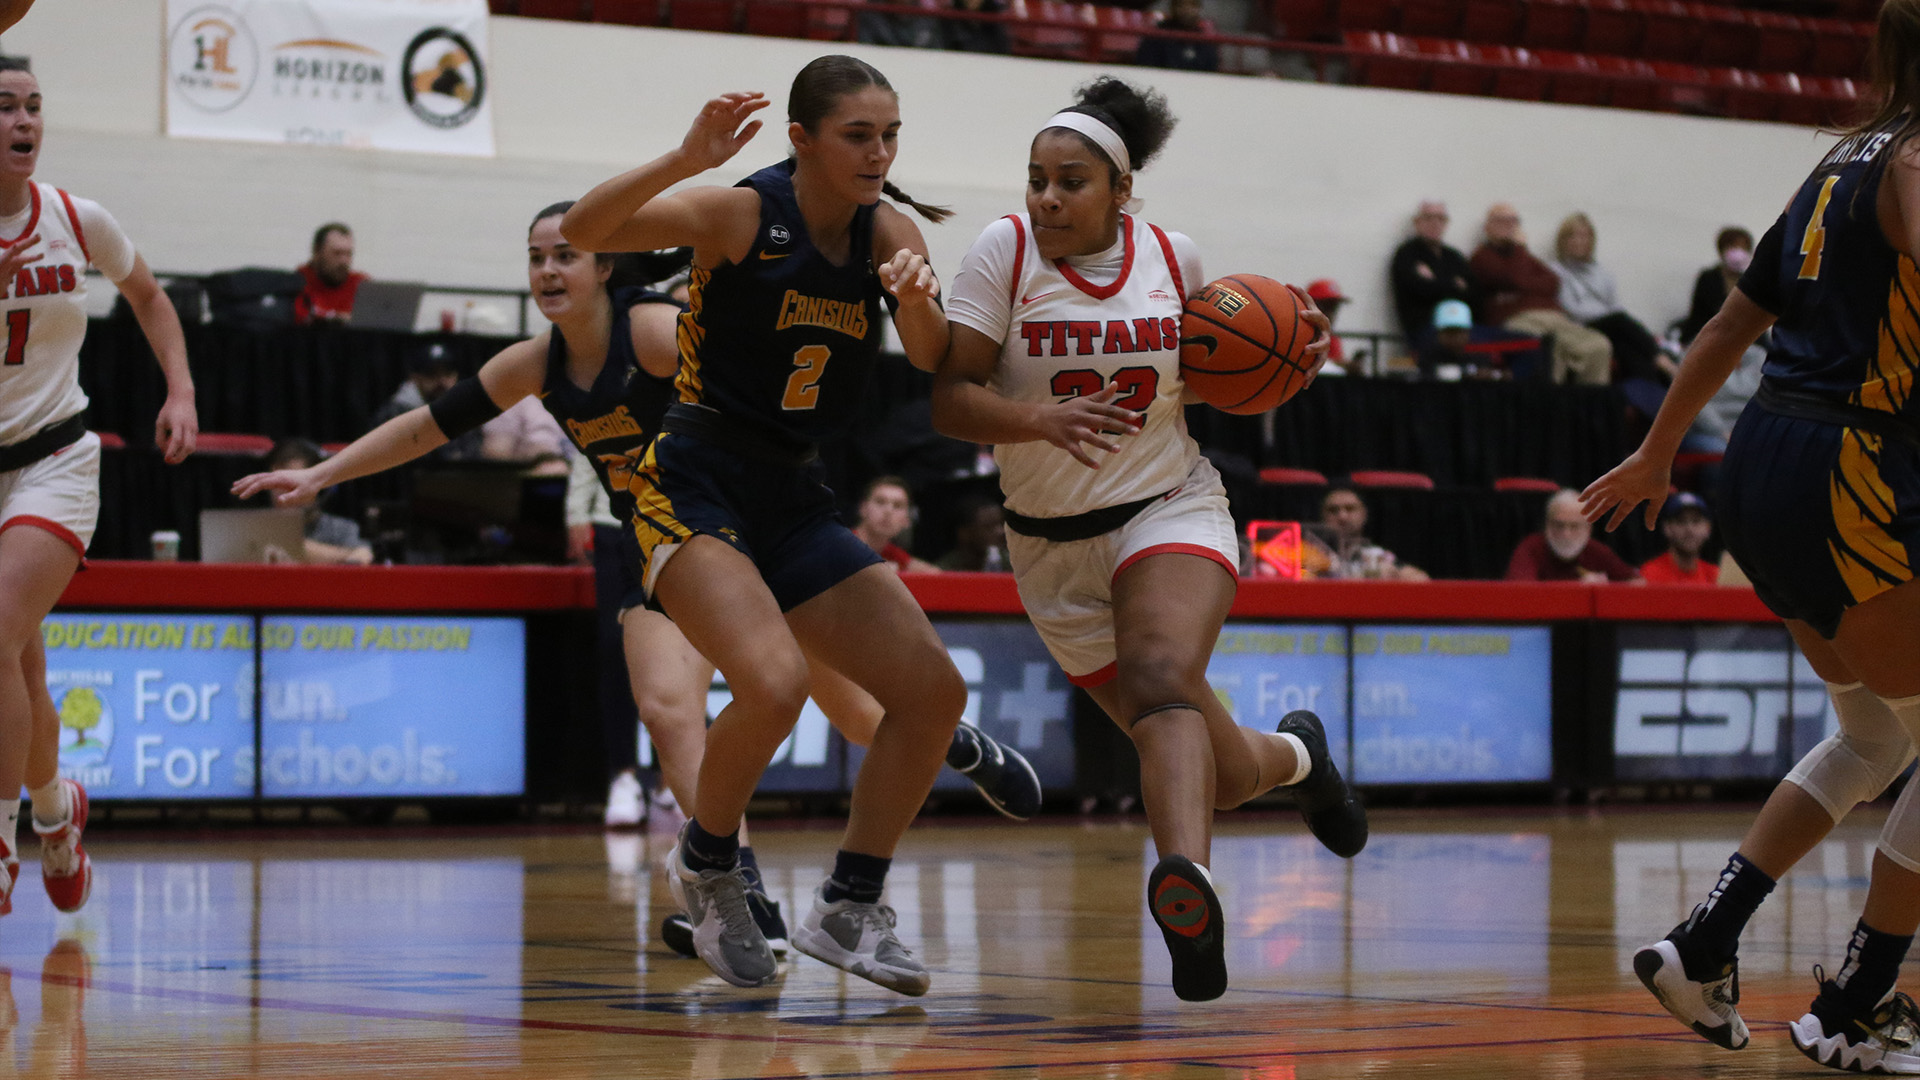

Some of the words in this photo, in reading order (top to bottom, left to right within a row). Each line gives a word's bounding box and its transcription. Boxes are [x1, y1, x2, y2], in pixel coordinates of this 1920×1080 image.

[275, 58, 385, 85] HORIZON
[771, 228, 789, 240] BLM
[1797, 175, 1841, 280] 4
[4, 308, 31, 366] 1
[776, 289, 868, 340] CANISIUS
[1021, 317, 1180, 357] TITANS
[781, 345, 832, 410] 2
[191, 623, 216, 649] IS
[301, 624, 355, 650] OUR
[361, 625, 472, 650] PASSION
[135, 670, 220, 722] For
[1258, 672, 1322, 716] For
[1614, 649, 1842, 756] ESP
[135, 735, 220, 787] For
